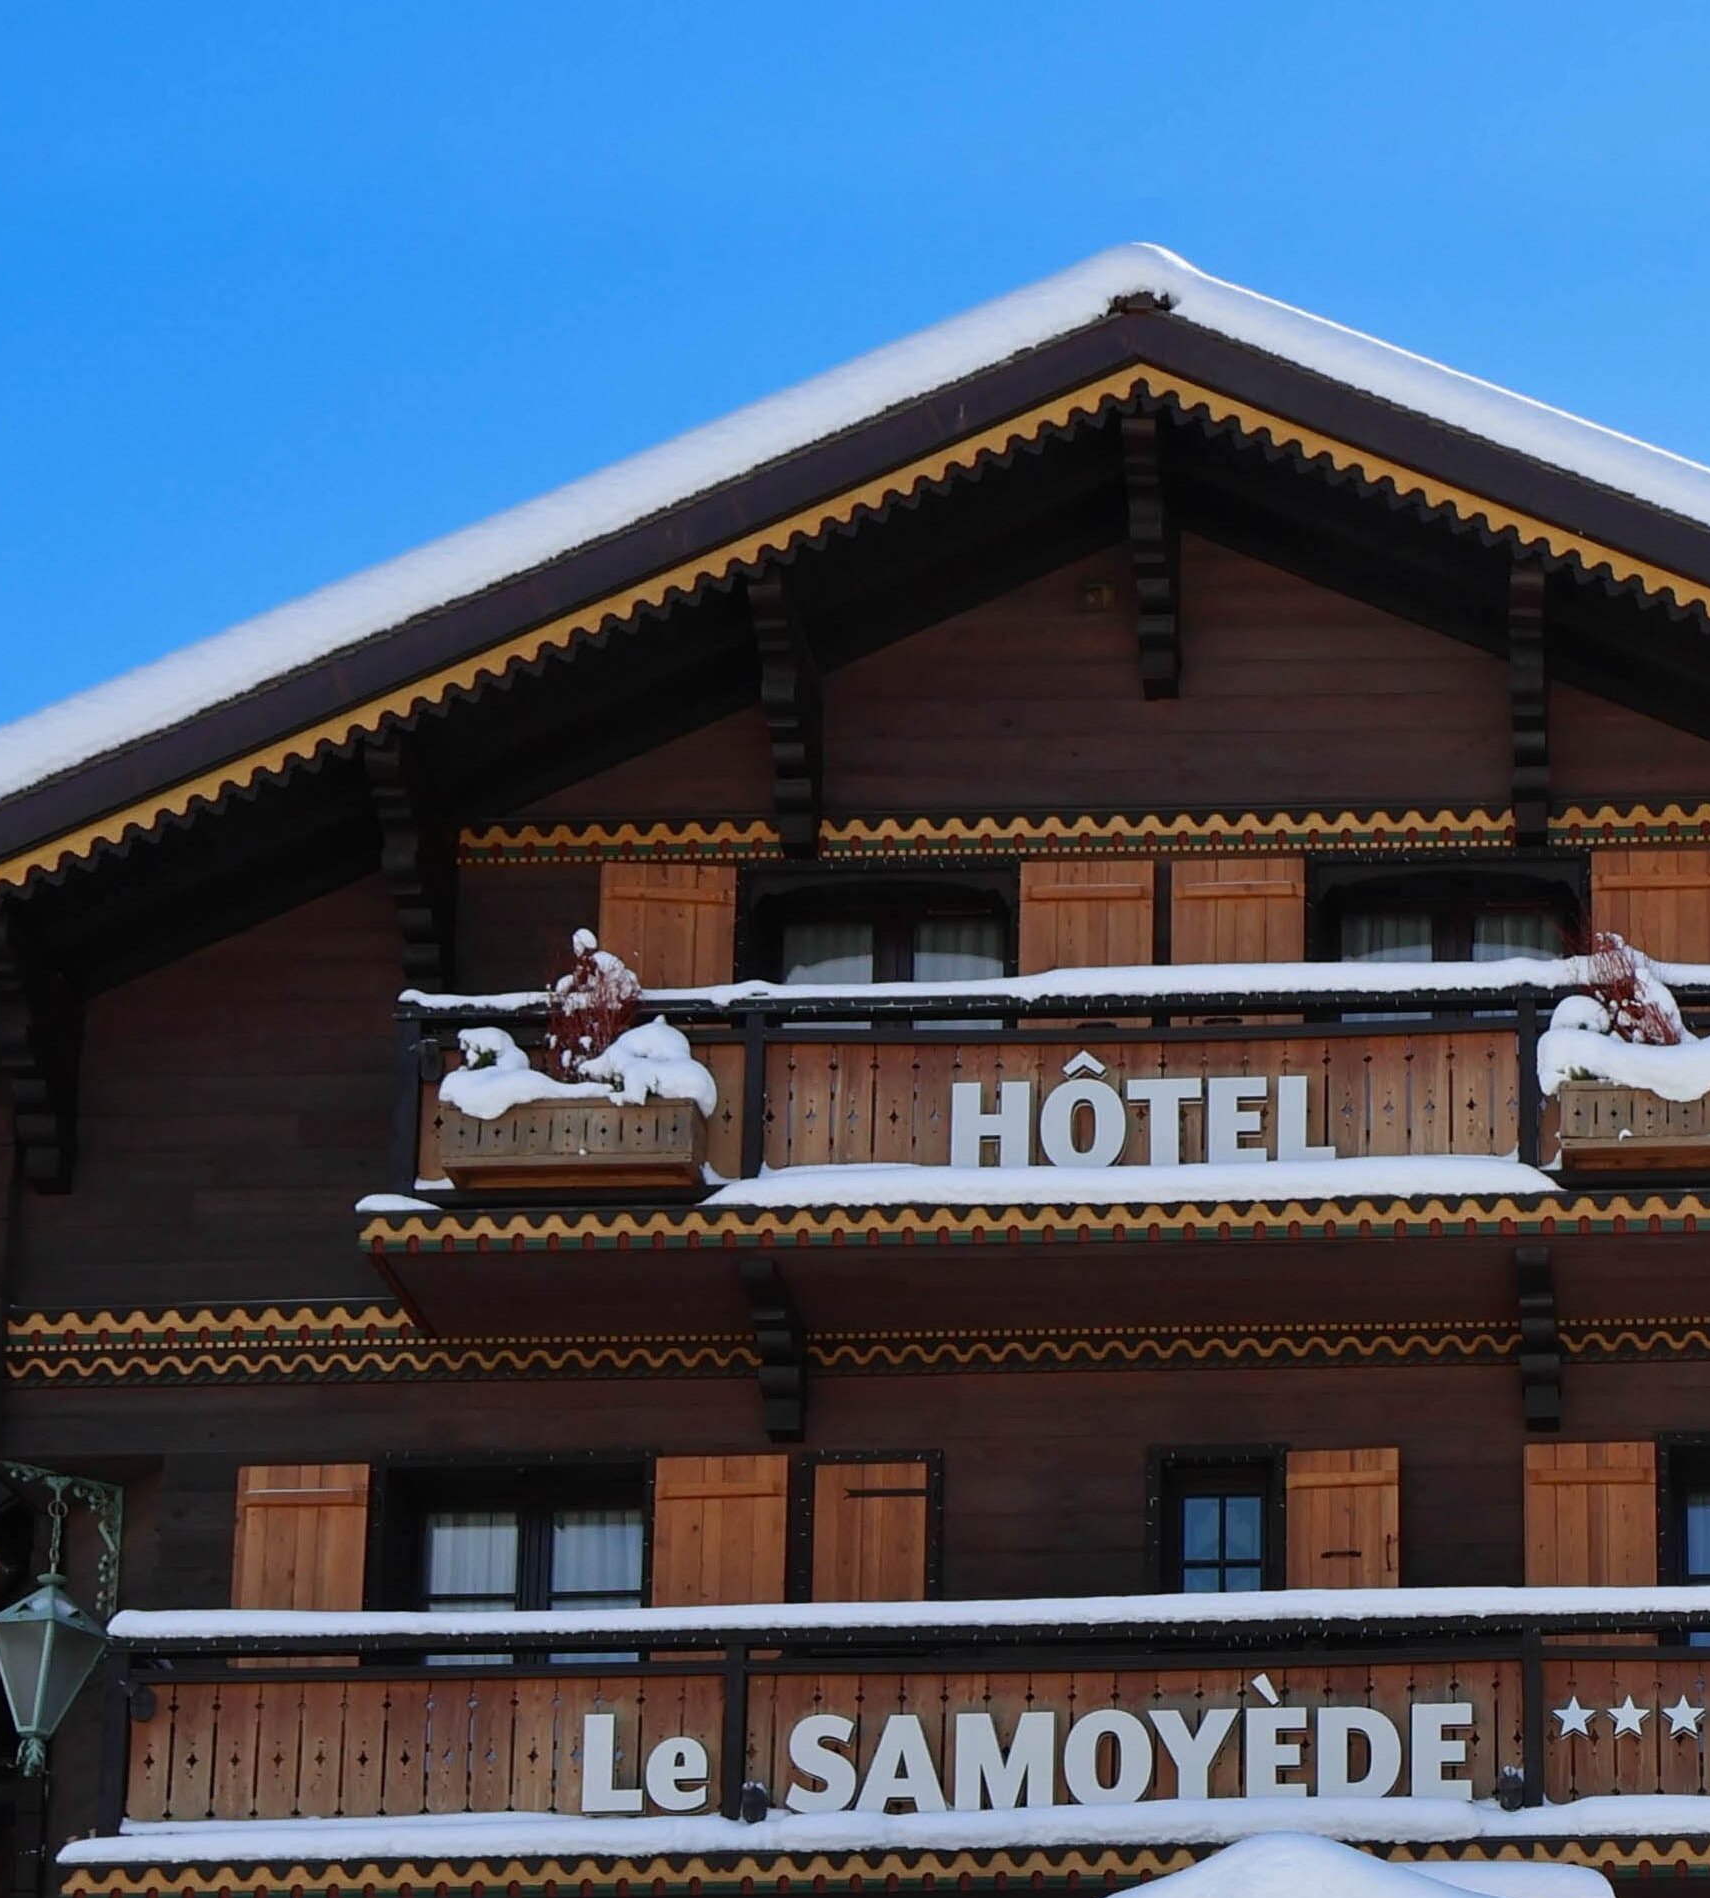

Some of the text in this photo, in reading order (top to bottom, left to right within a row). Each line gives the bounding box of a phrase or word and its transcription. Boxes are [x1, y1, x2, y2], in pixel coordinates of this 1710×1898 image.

[950, 1050, 1337, 1167] HÔTEL
[580, 1672, 1474, 1814] Le SAMOYÈDE
